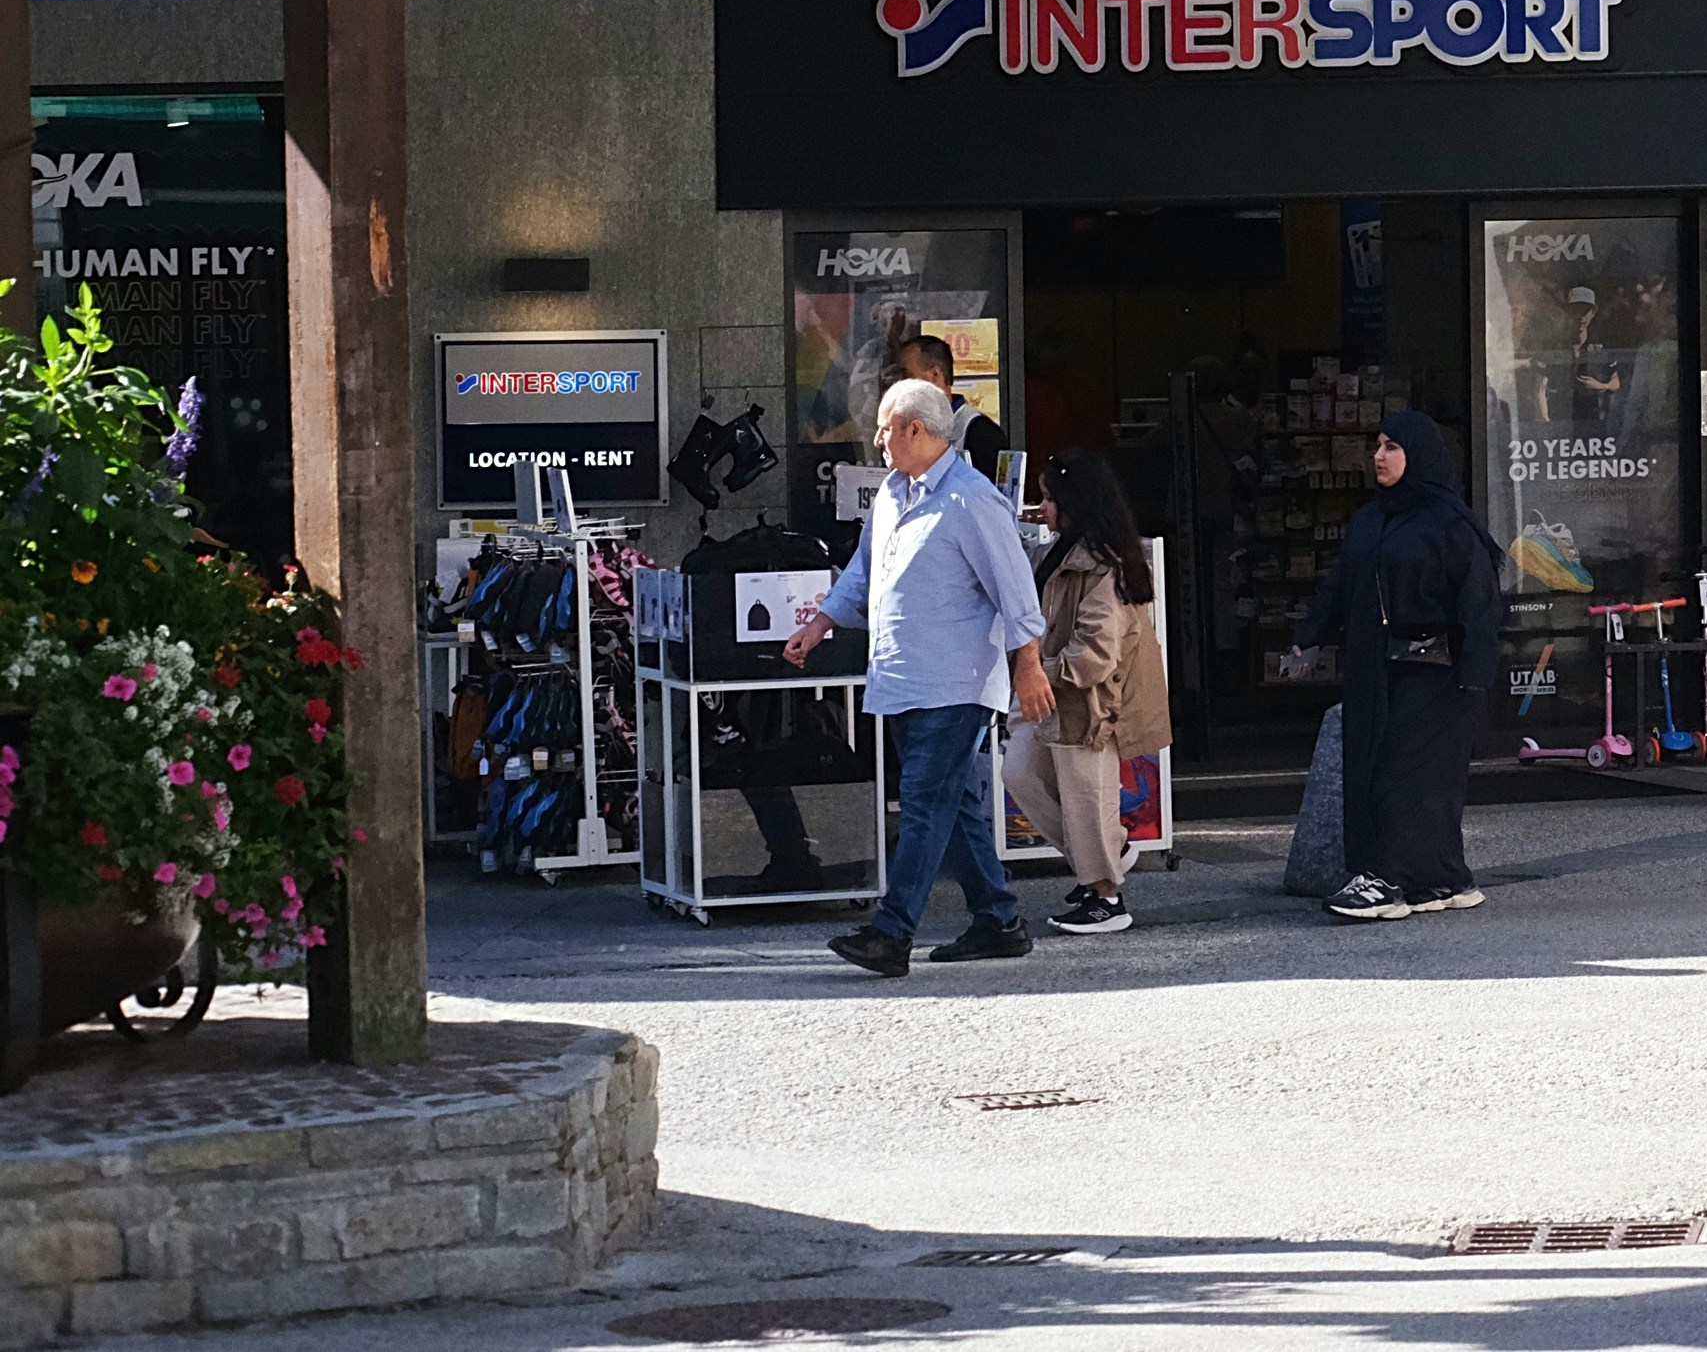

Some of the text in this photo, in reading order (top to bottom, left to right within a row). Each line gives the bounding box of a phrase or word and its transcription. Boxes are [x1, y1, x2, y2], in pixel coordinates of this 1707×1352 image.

[1505, 233, 1596, 264] HOKA
[816, 247, 912, 278] HOKA
[479, 370, 642, 395] INTERSPORT
[1508, 436, 1617, 459] 20 YEARS
[468, 451, 567, 469] LOCATION
[583, 450, 635, 467] RENT
[1508, 461, 1539, 482] OF
[1510, 604, 1549, 613] STINSON
